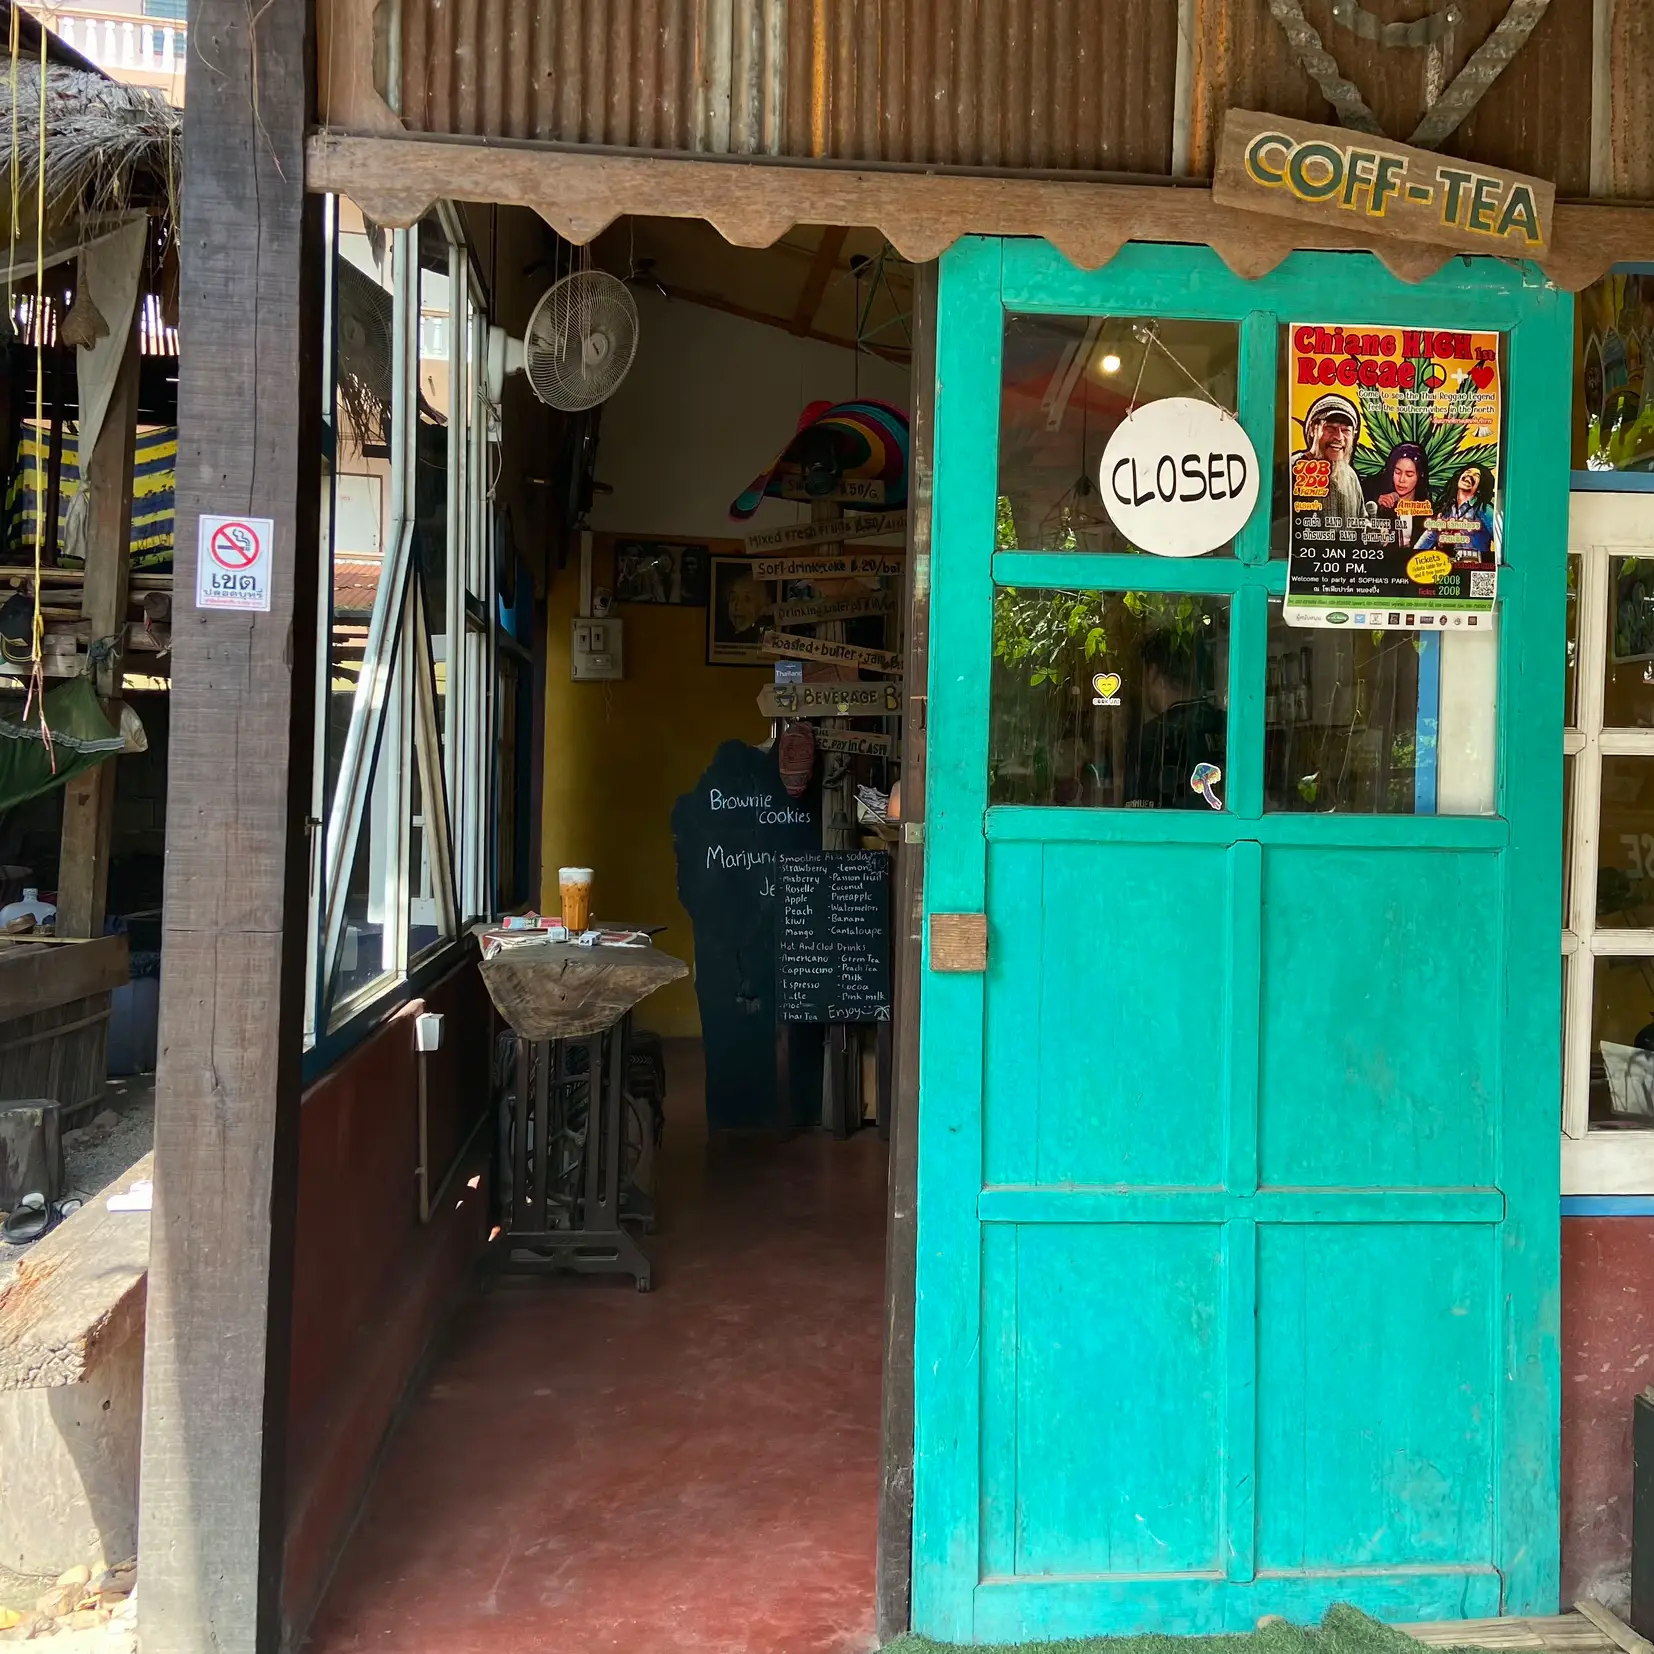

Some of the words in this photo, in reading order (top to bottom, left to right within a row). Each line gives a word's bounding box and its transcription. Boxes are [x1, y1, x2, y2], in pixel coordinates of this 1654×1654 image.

[1244, 130, 1544, 247] COFF-TEA
[1401, 331, 1472, 362] HIGH
[1297, 357, 1417, 388] Reggae
[1359, 390, 1379, 399] Come
[1381, 391, 1390, 399] to
[1406, 391, 1419, 400] the
[1459, 404, 1471, 413] the
[1293, 460, 1331, 475] JOB
[1112, 451, 1247, 507] CLOSED
[1295, 474, 1329, 488] 2DO
[1325, 517, 1342, 527] BAND
[1347, 518, 1367, 528] PEACE
[1371, 518, 1391, 529] HOUSE
[1395, 520, 1408, 530] BAR
[1339, 531, 1357, 541] BAND
[1300, 548, 1316, 558] 20
[1322, 548, 1346, 559] JAN
[1352, 549, 1384, 560] 2023
[1414, 555, 1440, 565] Tickets
[1313, 562, 1340, 573] 7.00
[1345, 562, 1367, 574] PM.
[212, 573, 256, 591] เขต
[1291, 575, 1319, 583] Welcome
[1331, 577, 1347, 585] party
[1358, 577, 1389, 585] SOPHIA'S
[804, 688, 878, 706] BEVERAGE
[709, 788, 773, 811] Brownie
[759, 805, 811, 824] cookies
[785, 885, 815, 893] Roselle
[831, 882, 864, 891] Coconut
[785, 894, 809, 905] Apple
[831, 892, 873, 902] Pineapple
[785, 905, 814, 916] Peach
[830, 904, 879, 912] Watermelon
[831, 914, 866, 923] Banana
[785, 929, 814, 939] Mango
[830, 926, 882, 938] Cantaloupe
[780, 941, 796, 951] Hot
[799, 941, 815, 951] And
[836, 942, 866, 952] Drinks
[781, 953, 829, 963] Americano
[866, 953, 880, 964] Tea
[781, 965, 834, 976] Cappuccino
[842, 973, 862, 982] Milk
[782, 979, 821, 991] Espresso
[865, 991, 887, 1001] milk
[804, 1011, 818, 1021] Tea
[828, 1004, 861, 1020] Enjoy
